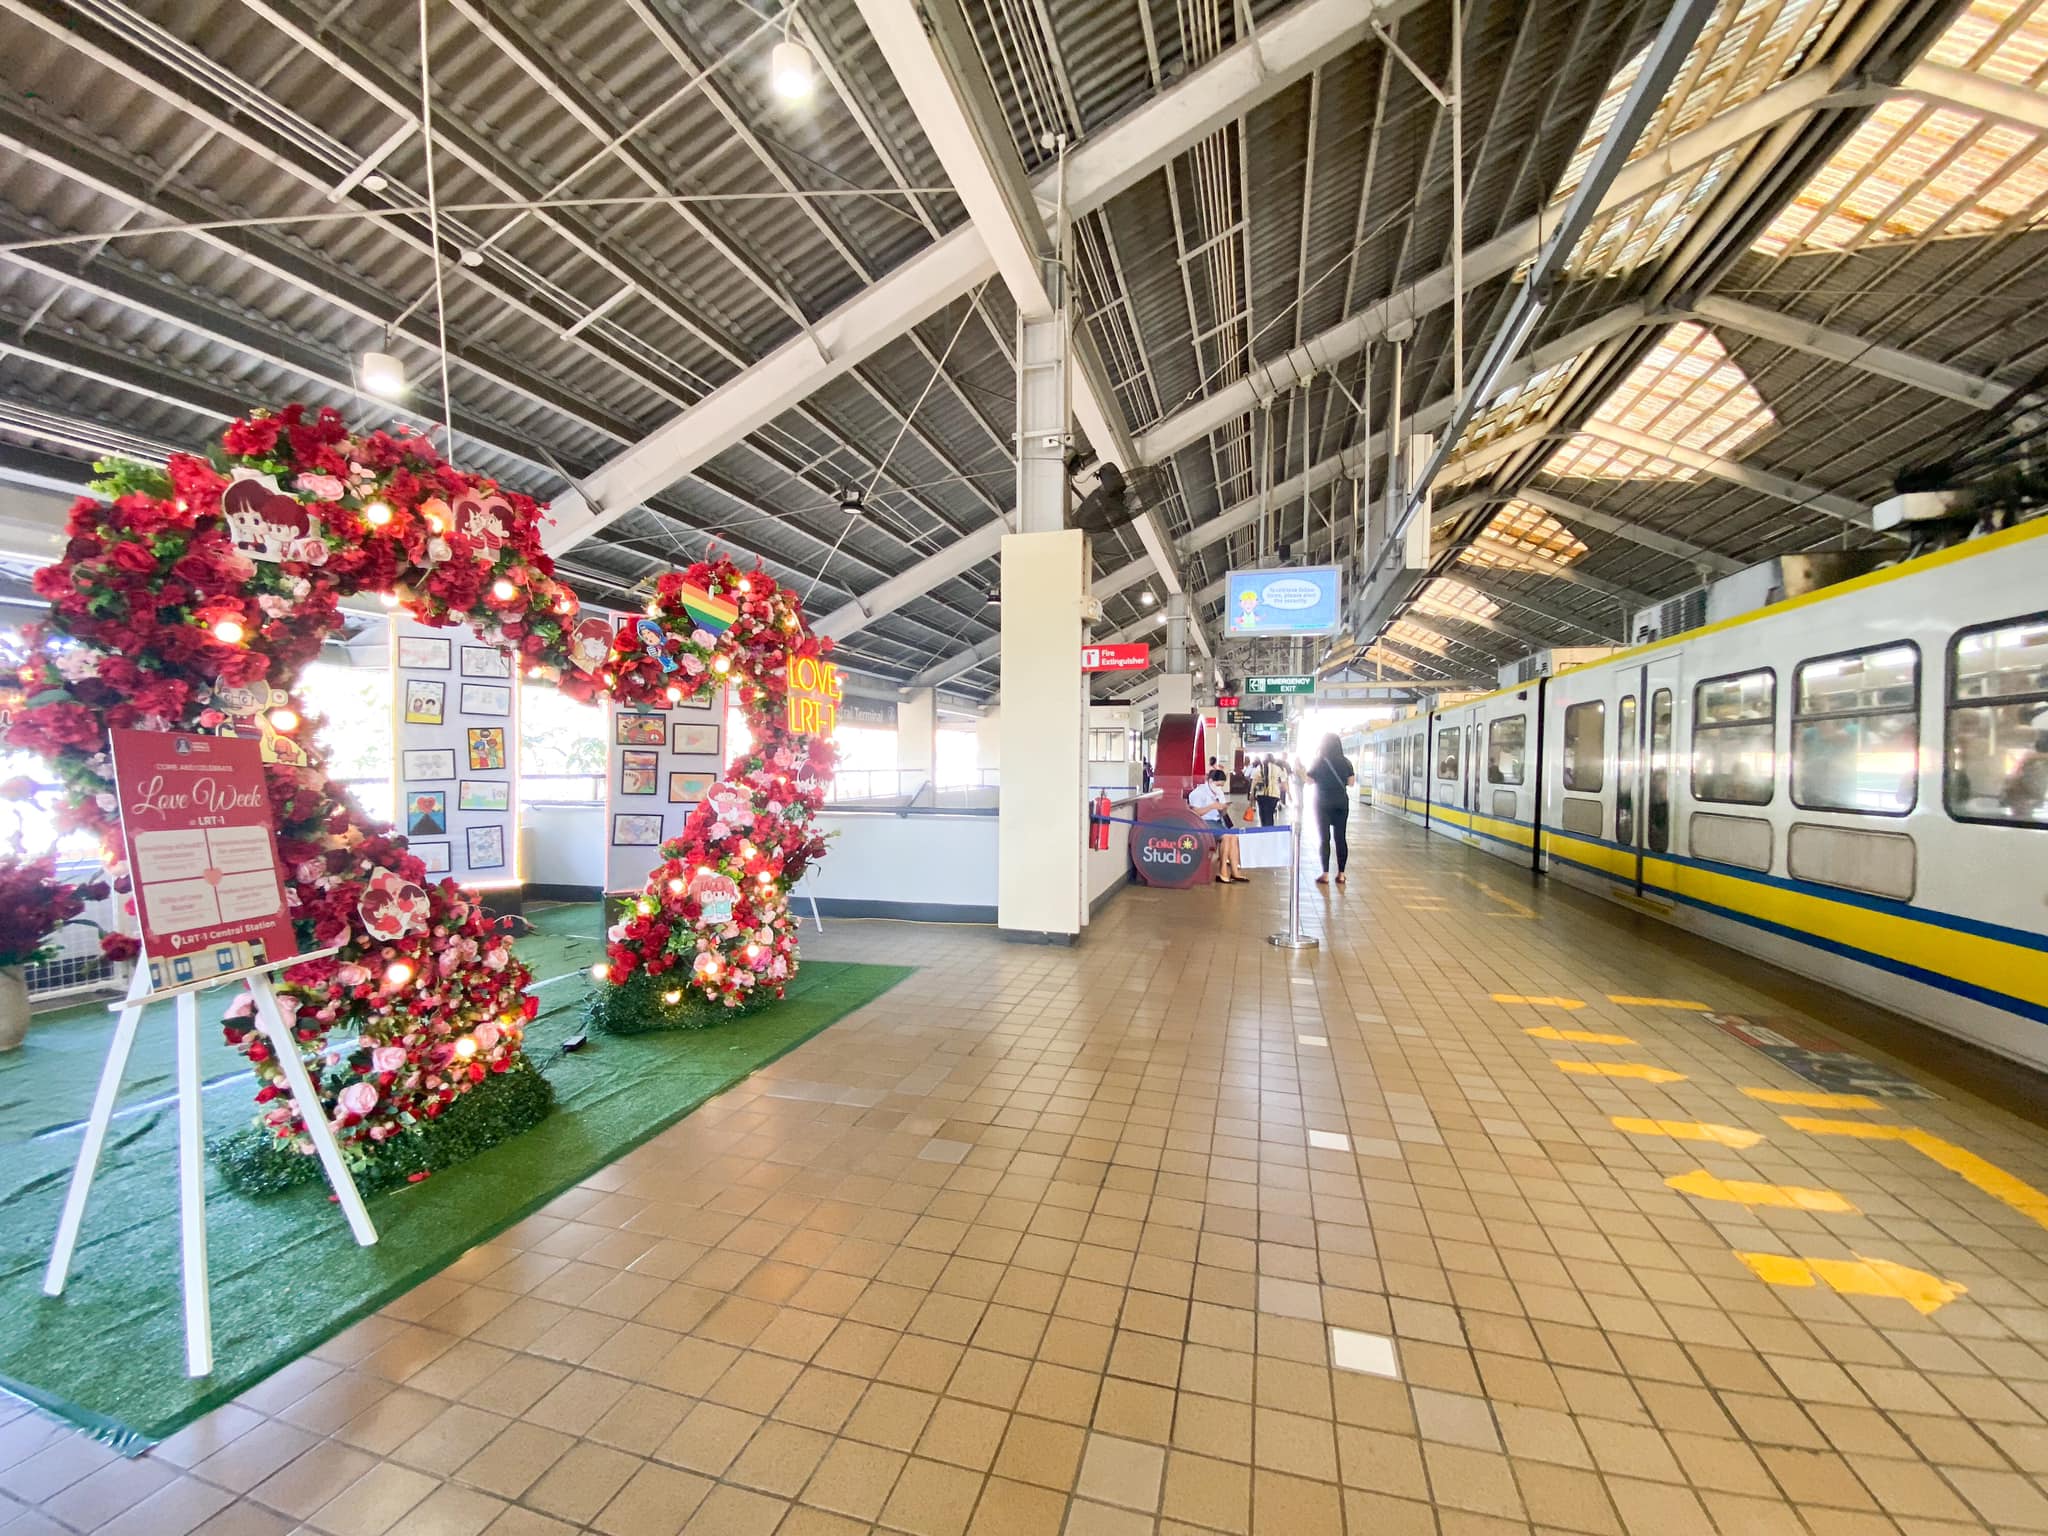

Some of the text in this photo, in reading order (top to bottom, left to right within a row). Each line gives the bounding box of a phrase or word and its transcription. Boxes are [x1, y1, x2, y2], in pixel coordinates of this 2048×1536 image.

[1101, 649, 1115, 657] Fire
[1101, 656, 1145, 667] Extinguisher
[1266, 677, 1311, 686] EMERGENCY
[1280, 685, 1296, 693] EXIT
[789, 696, 836, 737] LRT-1
[854, 706, 884, 723] Terminal
[131, 775, 263, 821] Love Week
[197, 815, 226, 826] LRT-1
[1148, 836, 1177, 849] Coke
[1142, 846, 1192, 865] Studio
[181, 920, 277, 946] LRT-1 Central Station
